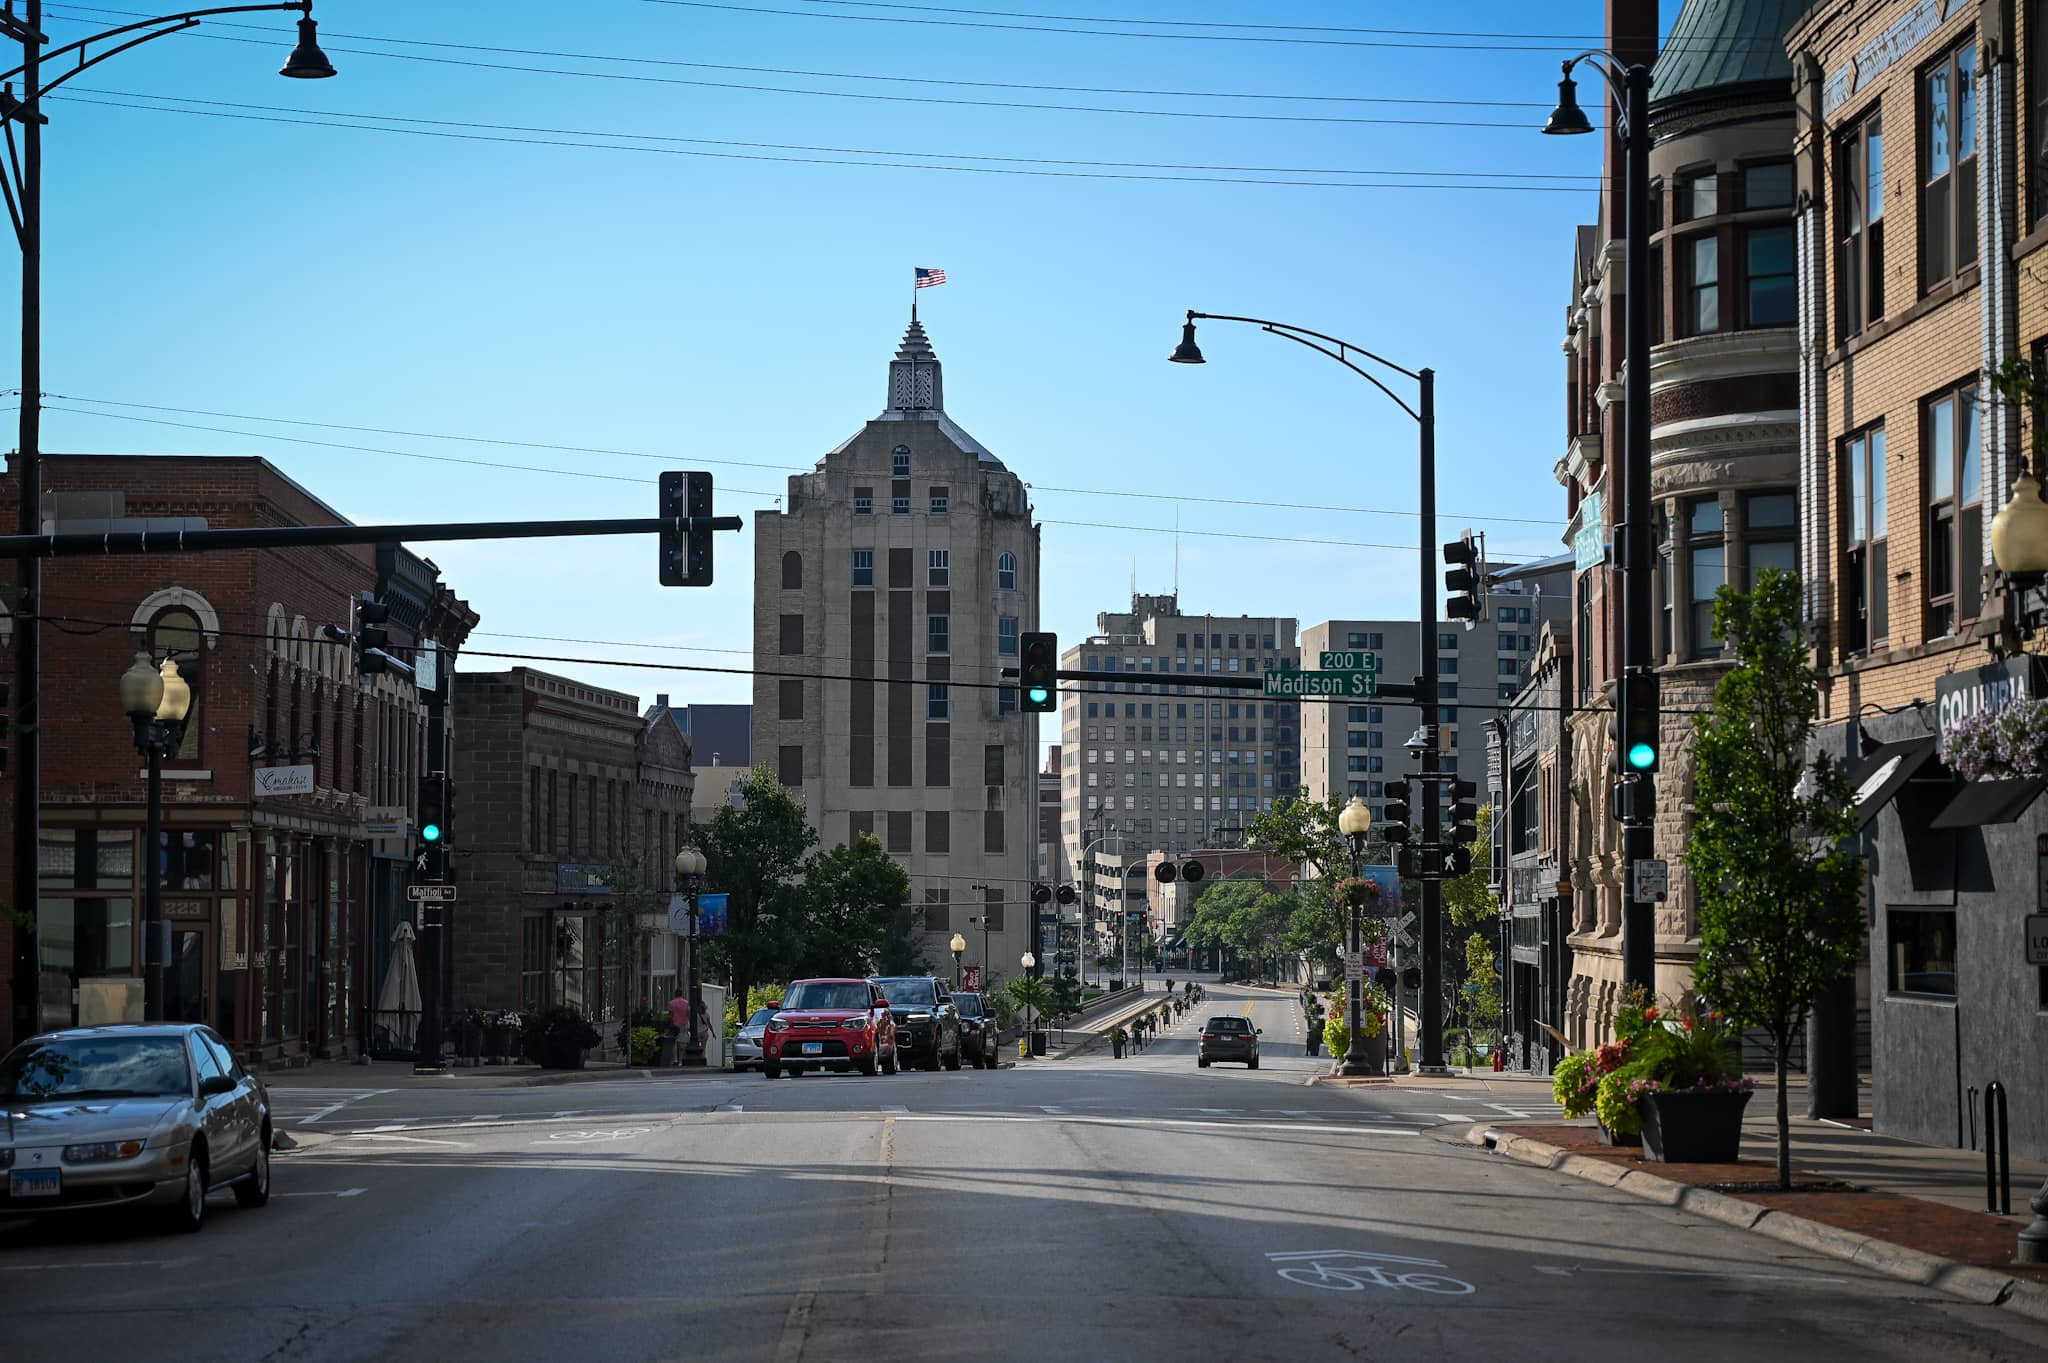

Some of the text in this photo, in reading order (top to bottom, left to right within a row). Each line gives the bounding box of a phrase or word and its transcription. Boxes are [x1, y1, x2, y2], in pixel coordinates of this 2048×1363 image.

[1324, 653, 1372, 669] 200 E
[1267, 672, 1372, 695] Madison St
